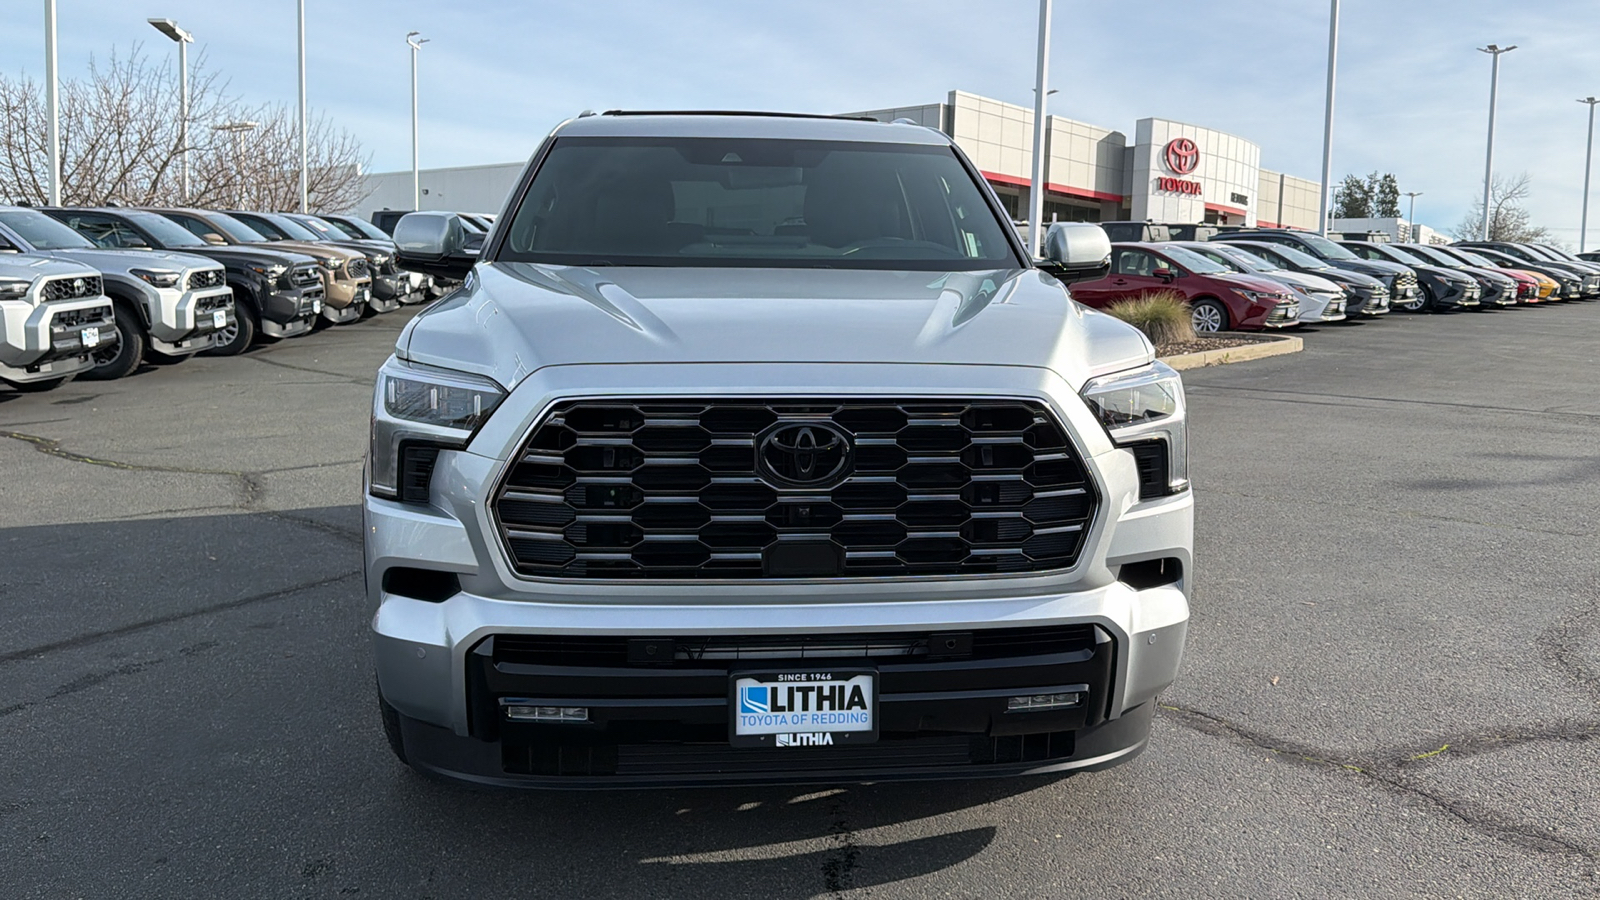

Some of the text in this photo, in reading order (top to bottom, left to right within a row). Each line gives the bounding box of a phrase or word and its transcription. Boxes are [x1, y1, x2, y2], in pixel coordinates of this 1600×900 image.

[1158, 177, 1202, 195] TOYOTA
[778, 673, 832, 682] SINCE 1946
[770, 685, 868, 713] LITHIA
[740, 712, 868, 727] TOYOTA OF REDDING
[789, 732, 834, 746] LITHIA
